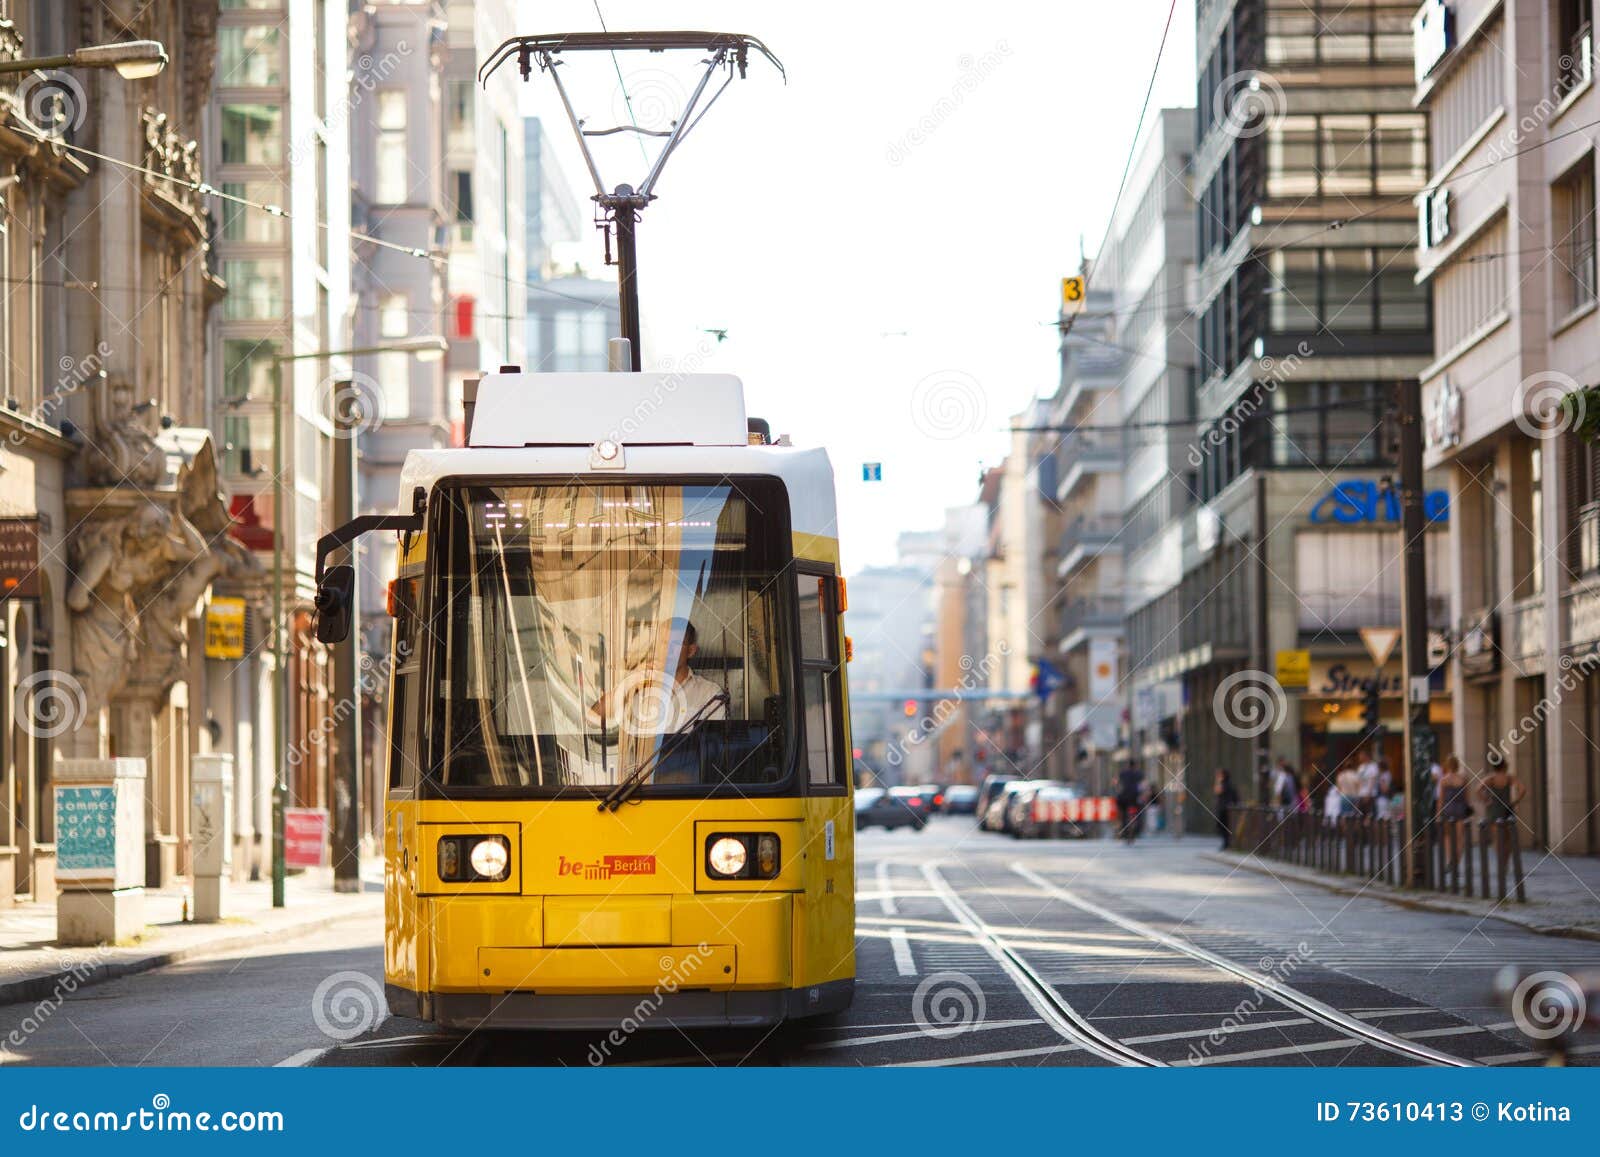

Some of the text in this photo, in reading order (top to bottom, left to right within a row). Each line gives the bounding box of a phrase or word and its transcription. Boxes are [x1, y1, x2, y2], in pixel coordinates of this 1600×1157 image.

[1066, 279, 1081, 301] 3
[558, 856, 651, 876] be Berlin
